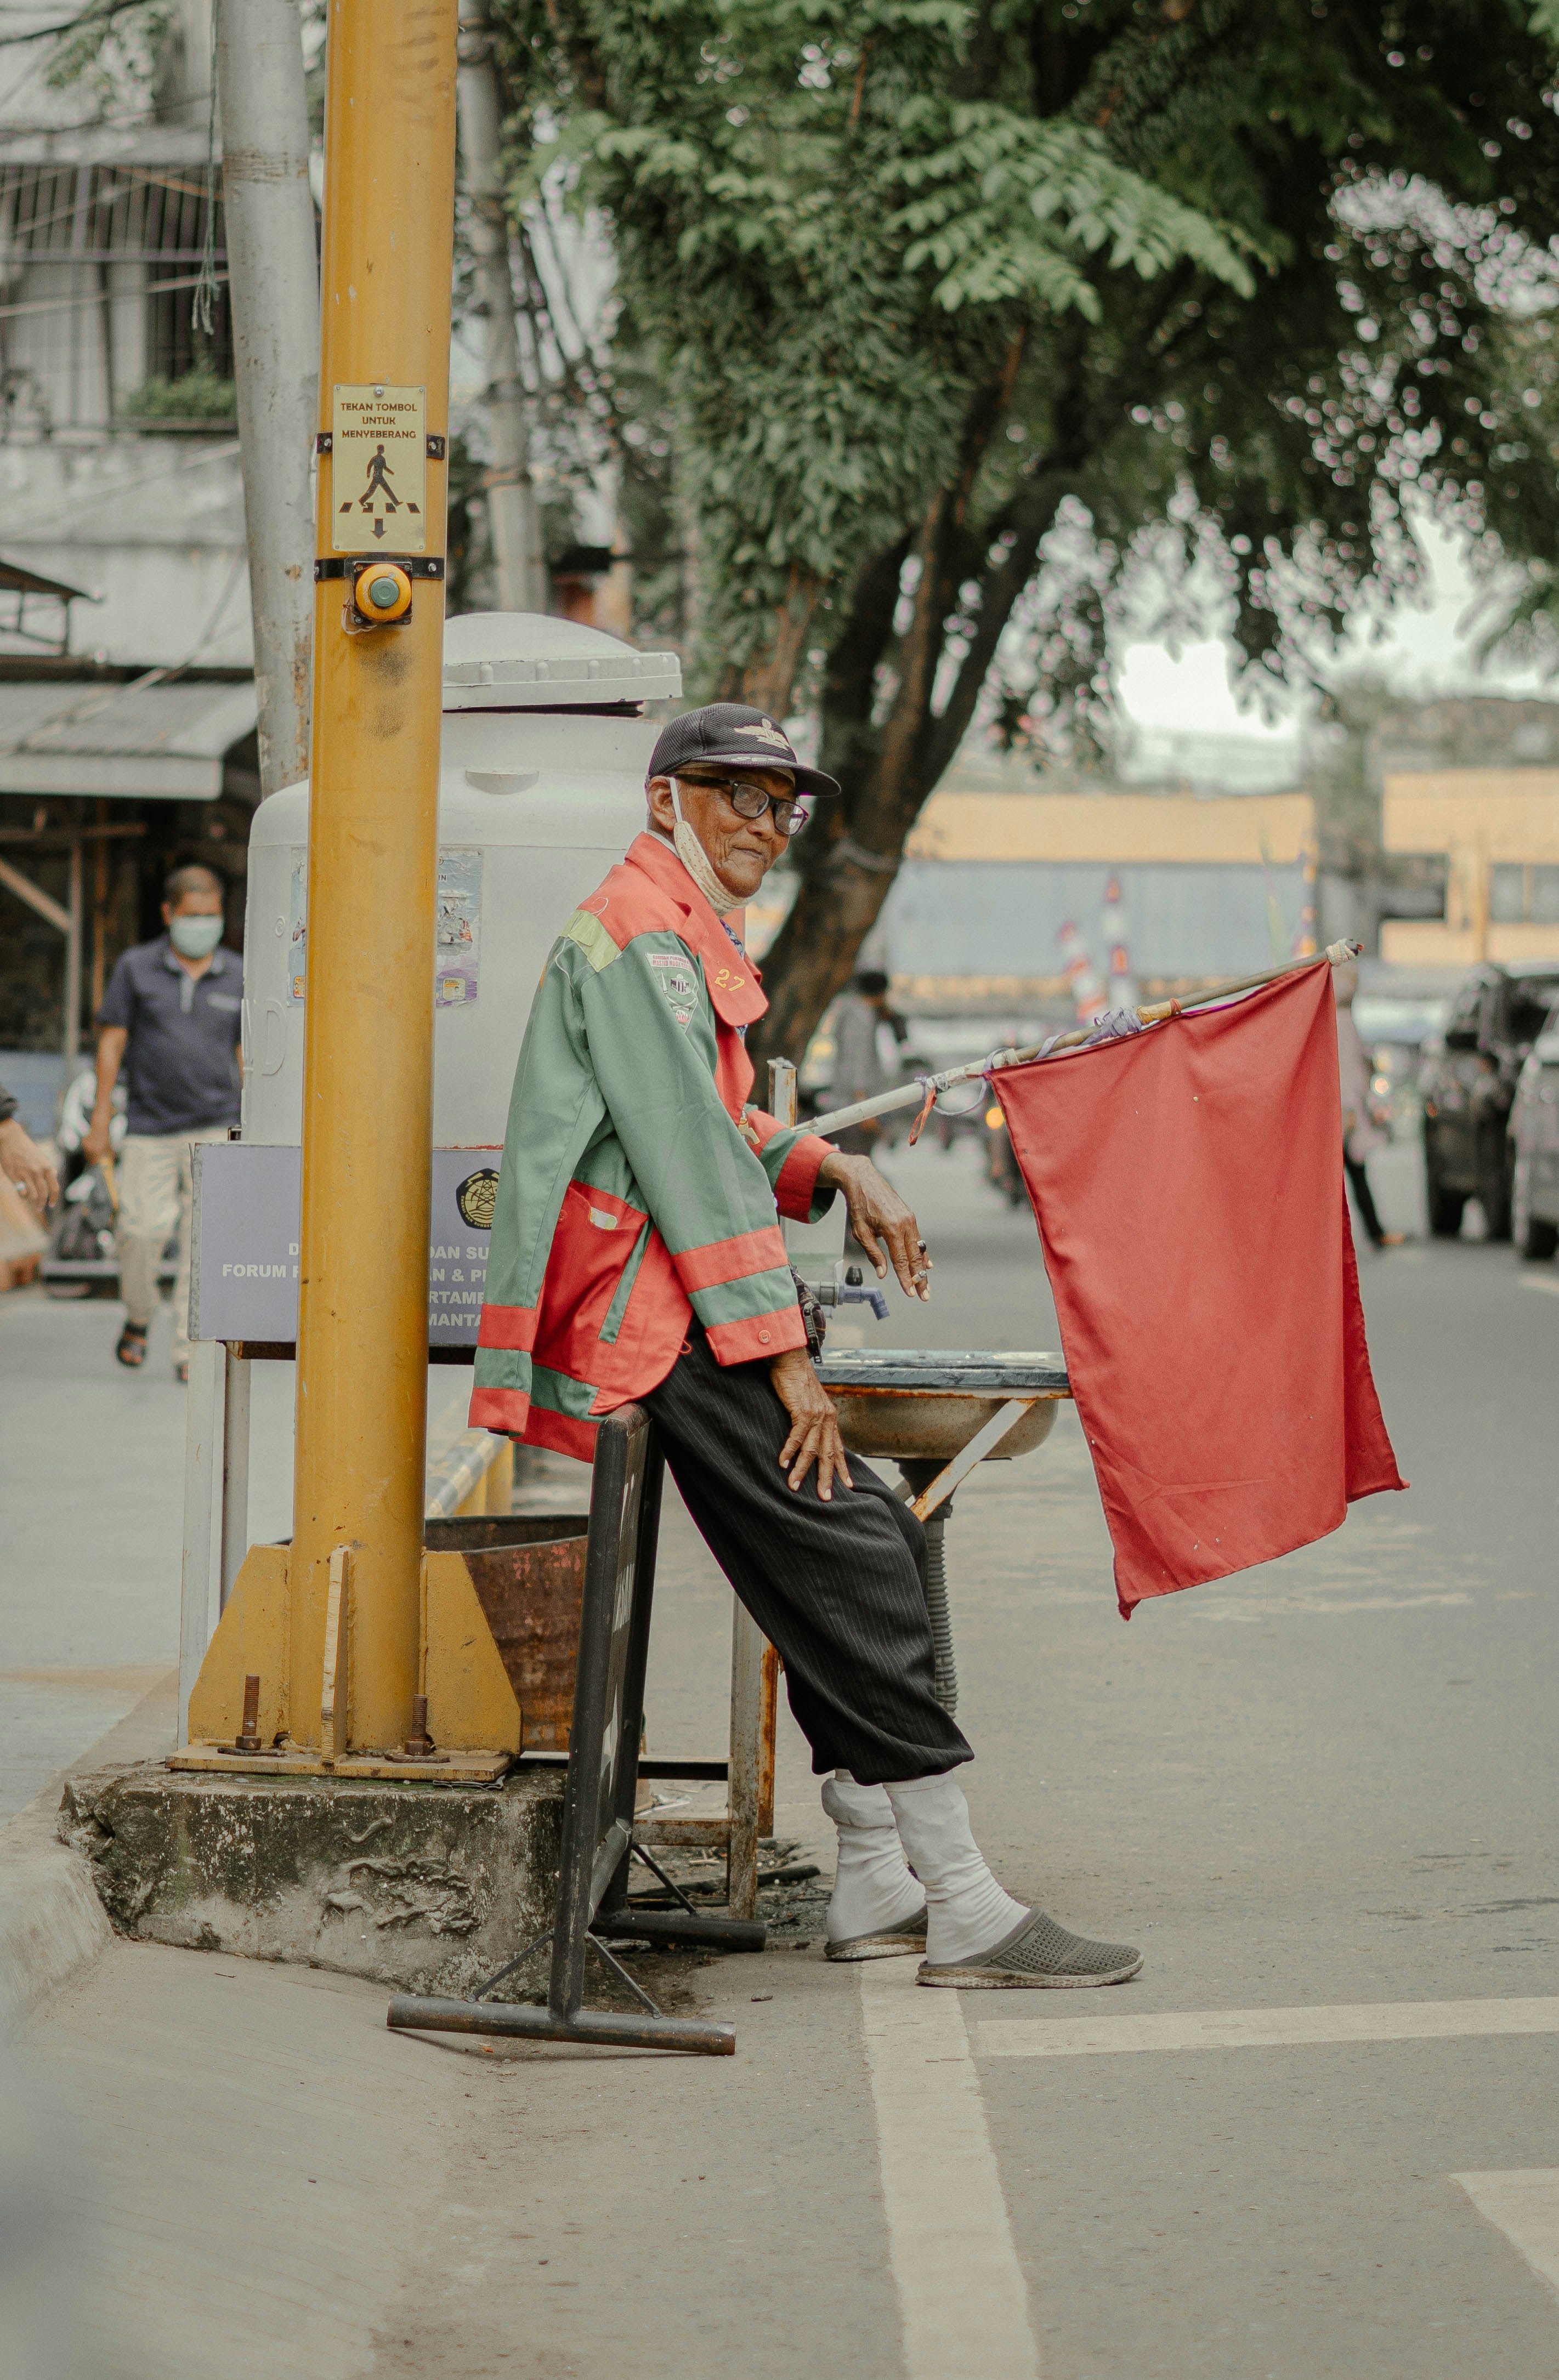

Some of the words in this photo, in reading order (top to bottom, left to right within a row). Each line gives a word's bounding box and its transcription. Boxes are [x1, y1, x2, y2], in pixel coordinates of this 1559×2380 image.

[341, 403, 373, 411] TEKAN
[376, 404, 417, 412] TOMBOL
[362, 417, 396, 425] UNTUK
[342, 430, 417, 439] MENYEBERANG
[714, 969, 745, 991] 27
[222, 1264, 287, 1278] FORUM
[451, 1268, 464, 1282] &
